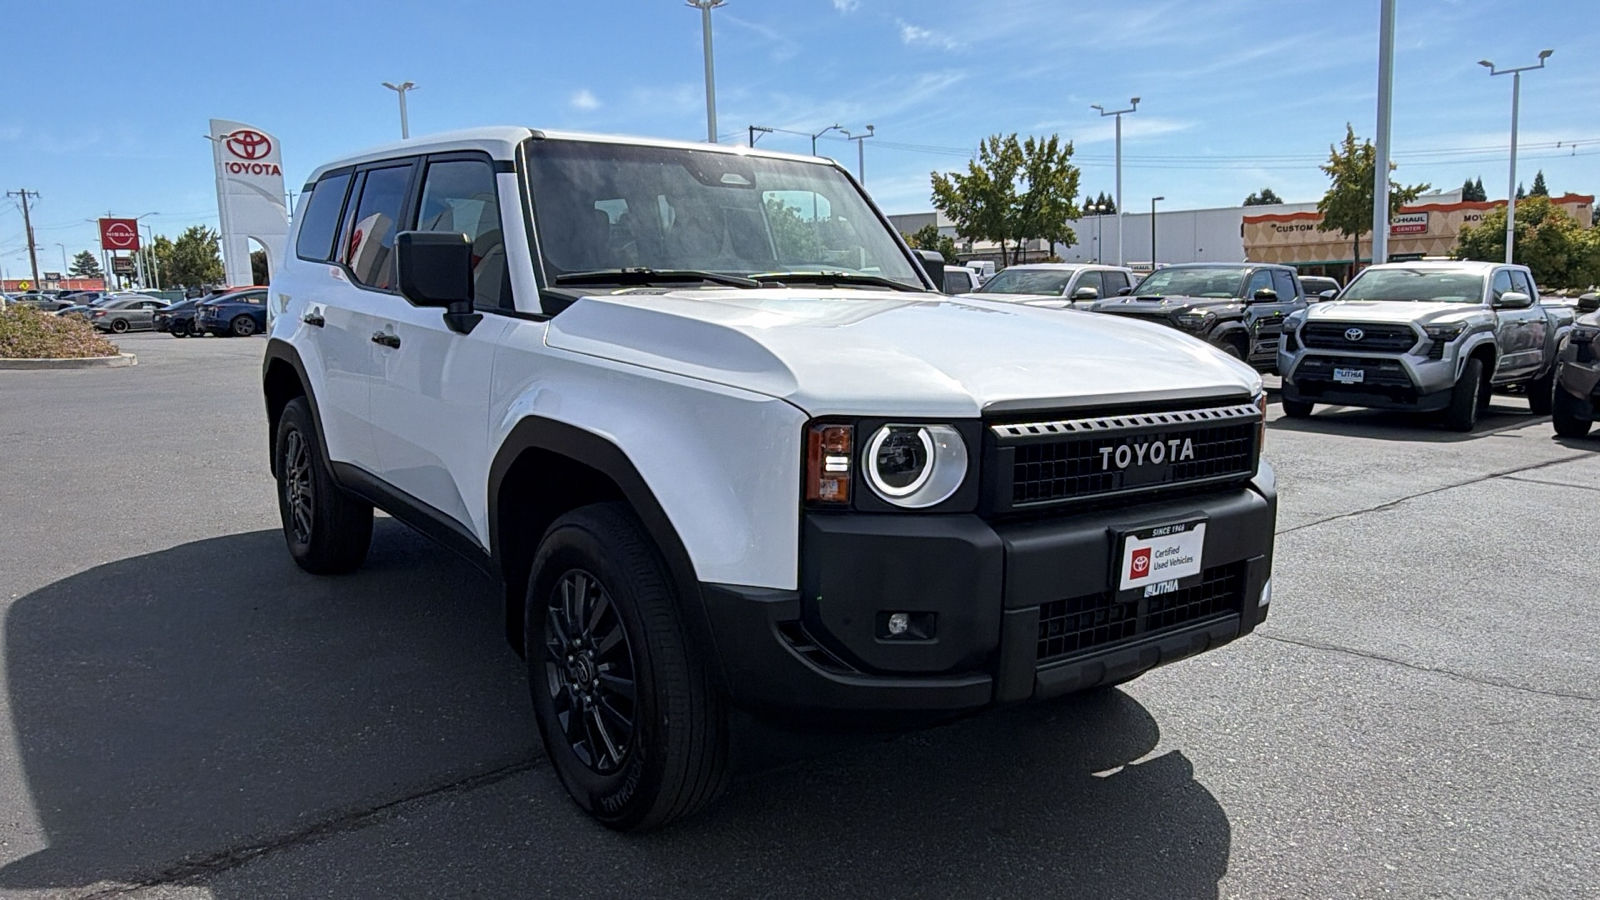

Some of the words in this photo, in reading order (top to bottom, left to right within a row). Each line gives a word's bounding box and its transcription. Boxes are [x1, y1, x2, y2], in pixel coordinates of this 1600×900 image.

[225, 162, 282, 176] TOYOTA
[1276, 224, 1313, 233] CUSTOM
[1340, 370, 1362, 378] LITHIA
[1099, 438, 1195, 470] TOYOTA
[1152, 526, 1171, 537] SINCE
[1171, 523, 1185, 533] 1946
[1155, 546, 1181, 558] Certified
[1153, 560, 1169, 571] Used
[1169, 556, 1193, 568] Vehicles
[1153, 578, 1179, 596] LITHIA
